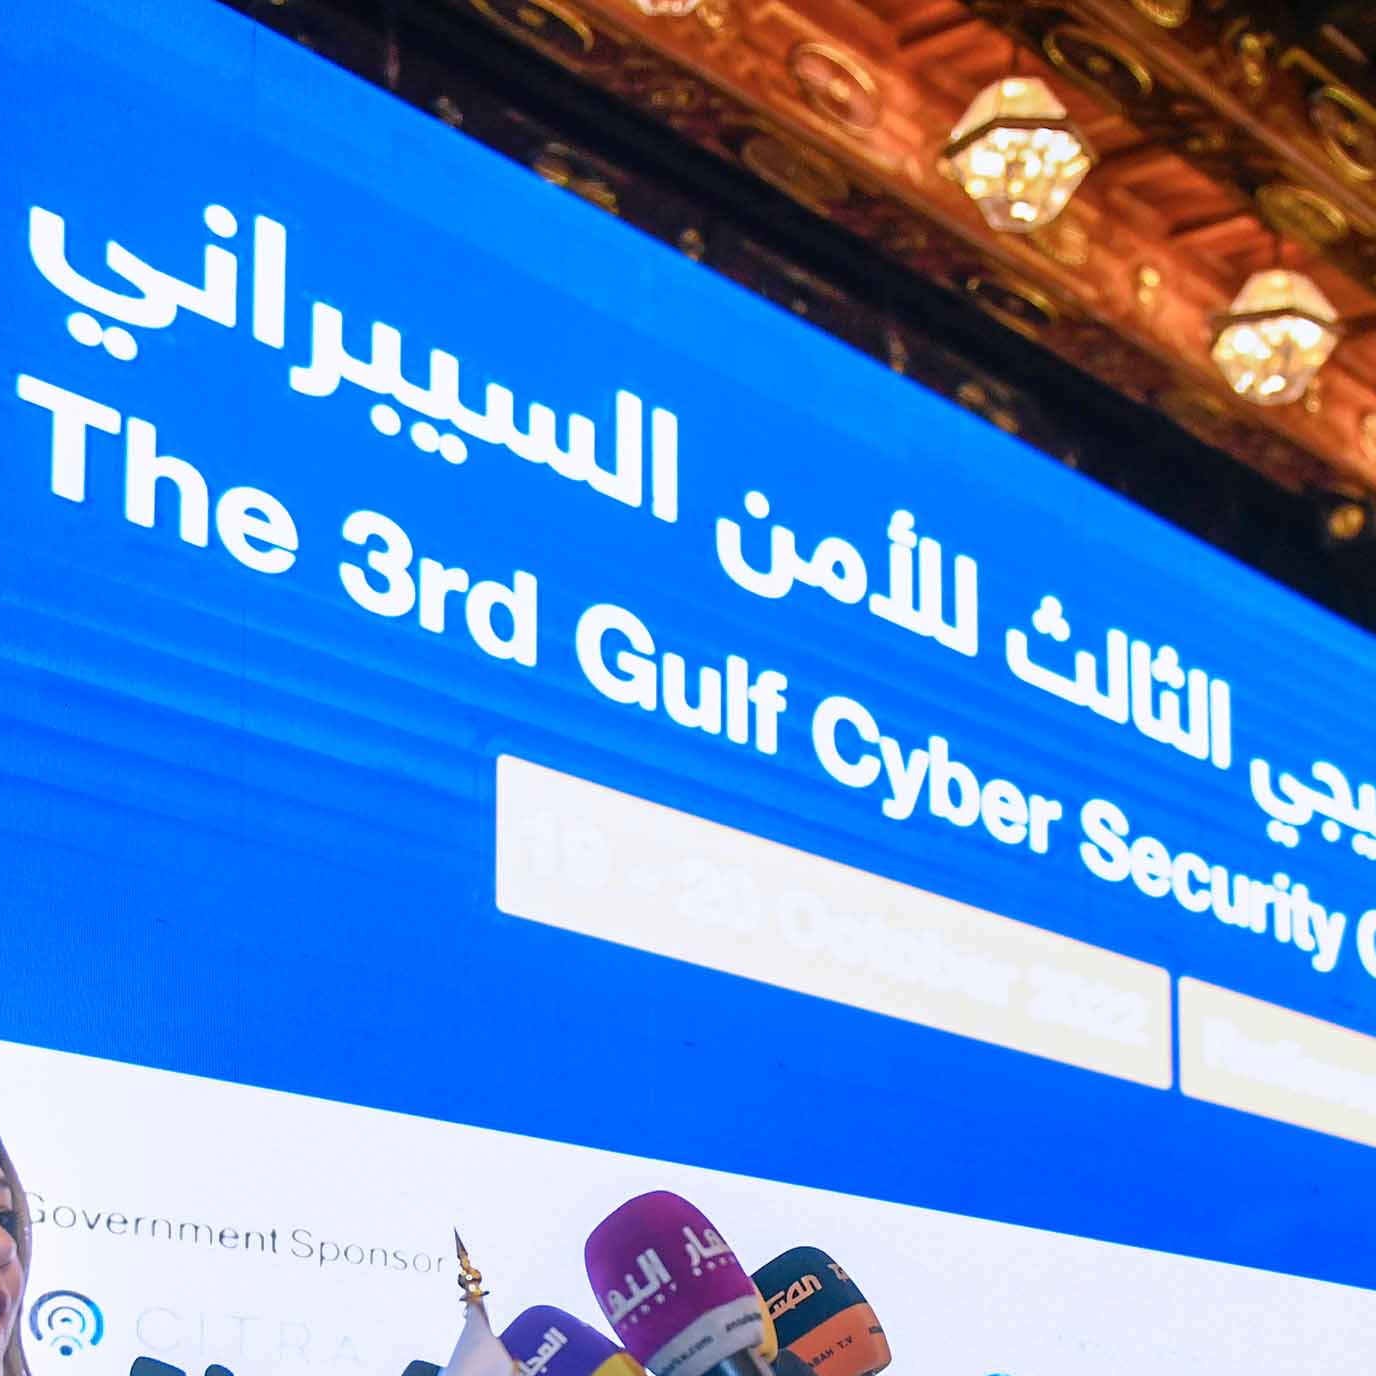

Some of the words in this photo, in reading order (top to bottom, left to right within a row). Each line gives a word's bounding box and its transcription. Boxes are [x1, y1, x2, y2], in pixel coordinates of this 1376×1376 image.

[29, 203, 678, 523] السيبراني
[716, 490, 978, 657] للأمن
[16, 372, 299, 574] The
[339, 510, 538, 667] 3rd
[575, 603, 788, 755] Gulf
[811, 695, 1063, 854] Cyber
[1079, 799, 1346, 973] Security
[1005, 595, 1231, 769] الثالث
[290, 1229, 446, 1274] Sponsor
